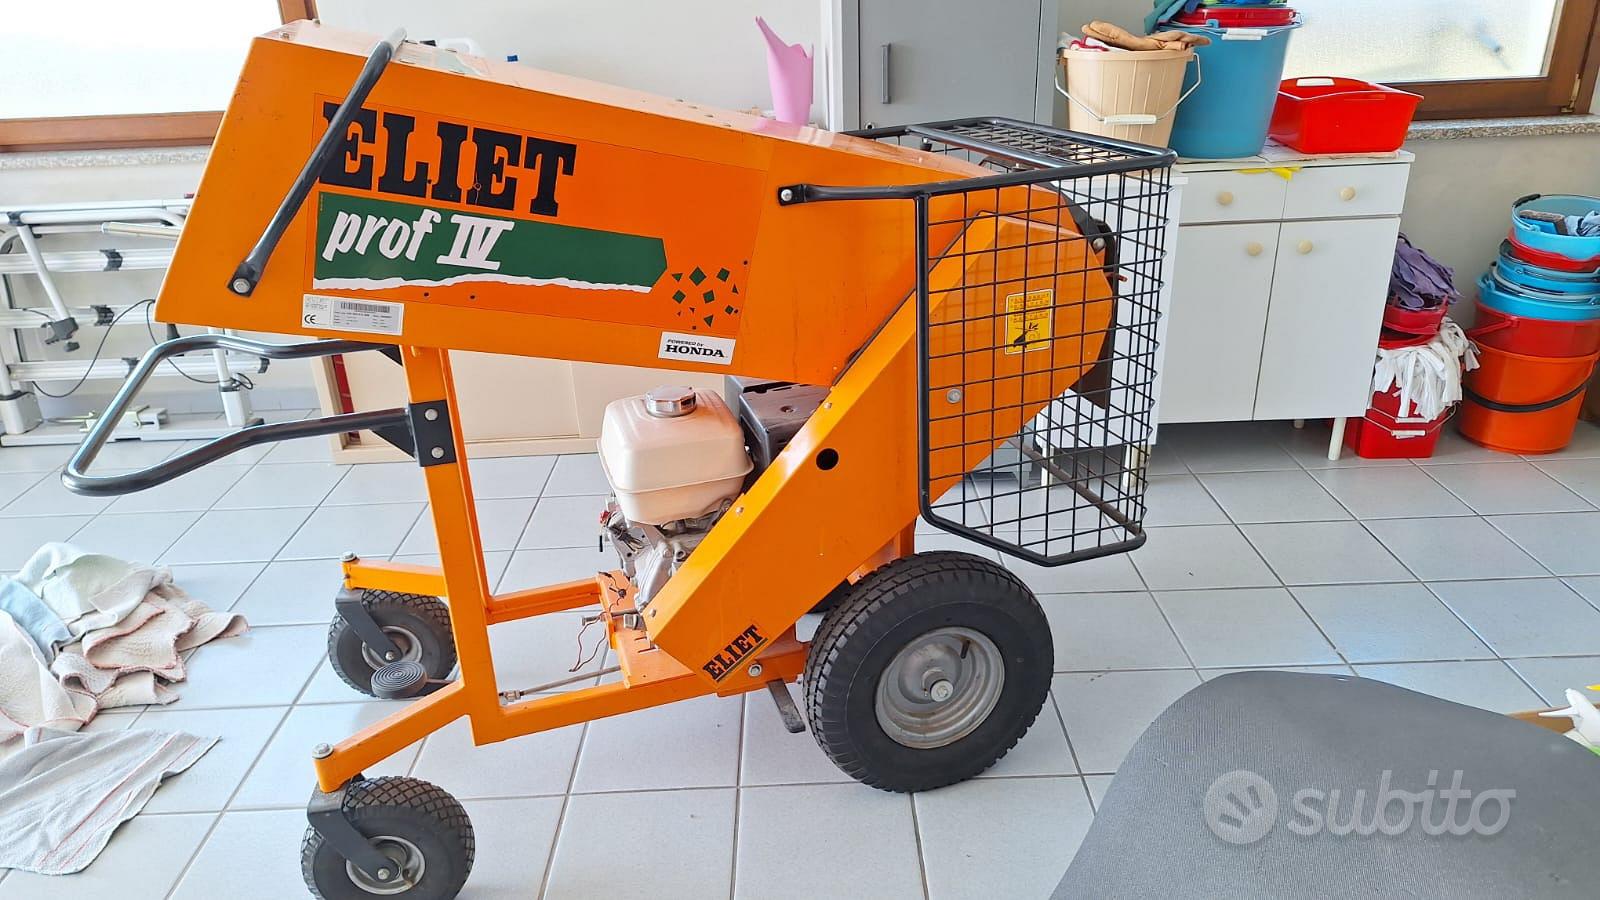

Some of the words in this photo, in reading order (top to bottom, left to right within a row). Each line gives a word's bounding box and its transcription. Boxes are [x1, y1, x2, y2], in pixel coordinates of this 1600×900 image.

[319, 102, 577, 217] ELIET
[322, 209, 442, 262] prof
[436, 214, 515, 271] IV
[304, 314, 316, 324] CE
[665, 344, 725, 358] HONDA
[703, 624, 763, 680] ELIET
